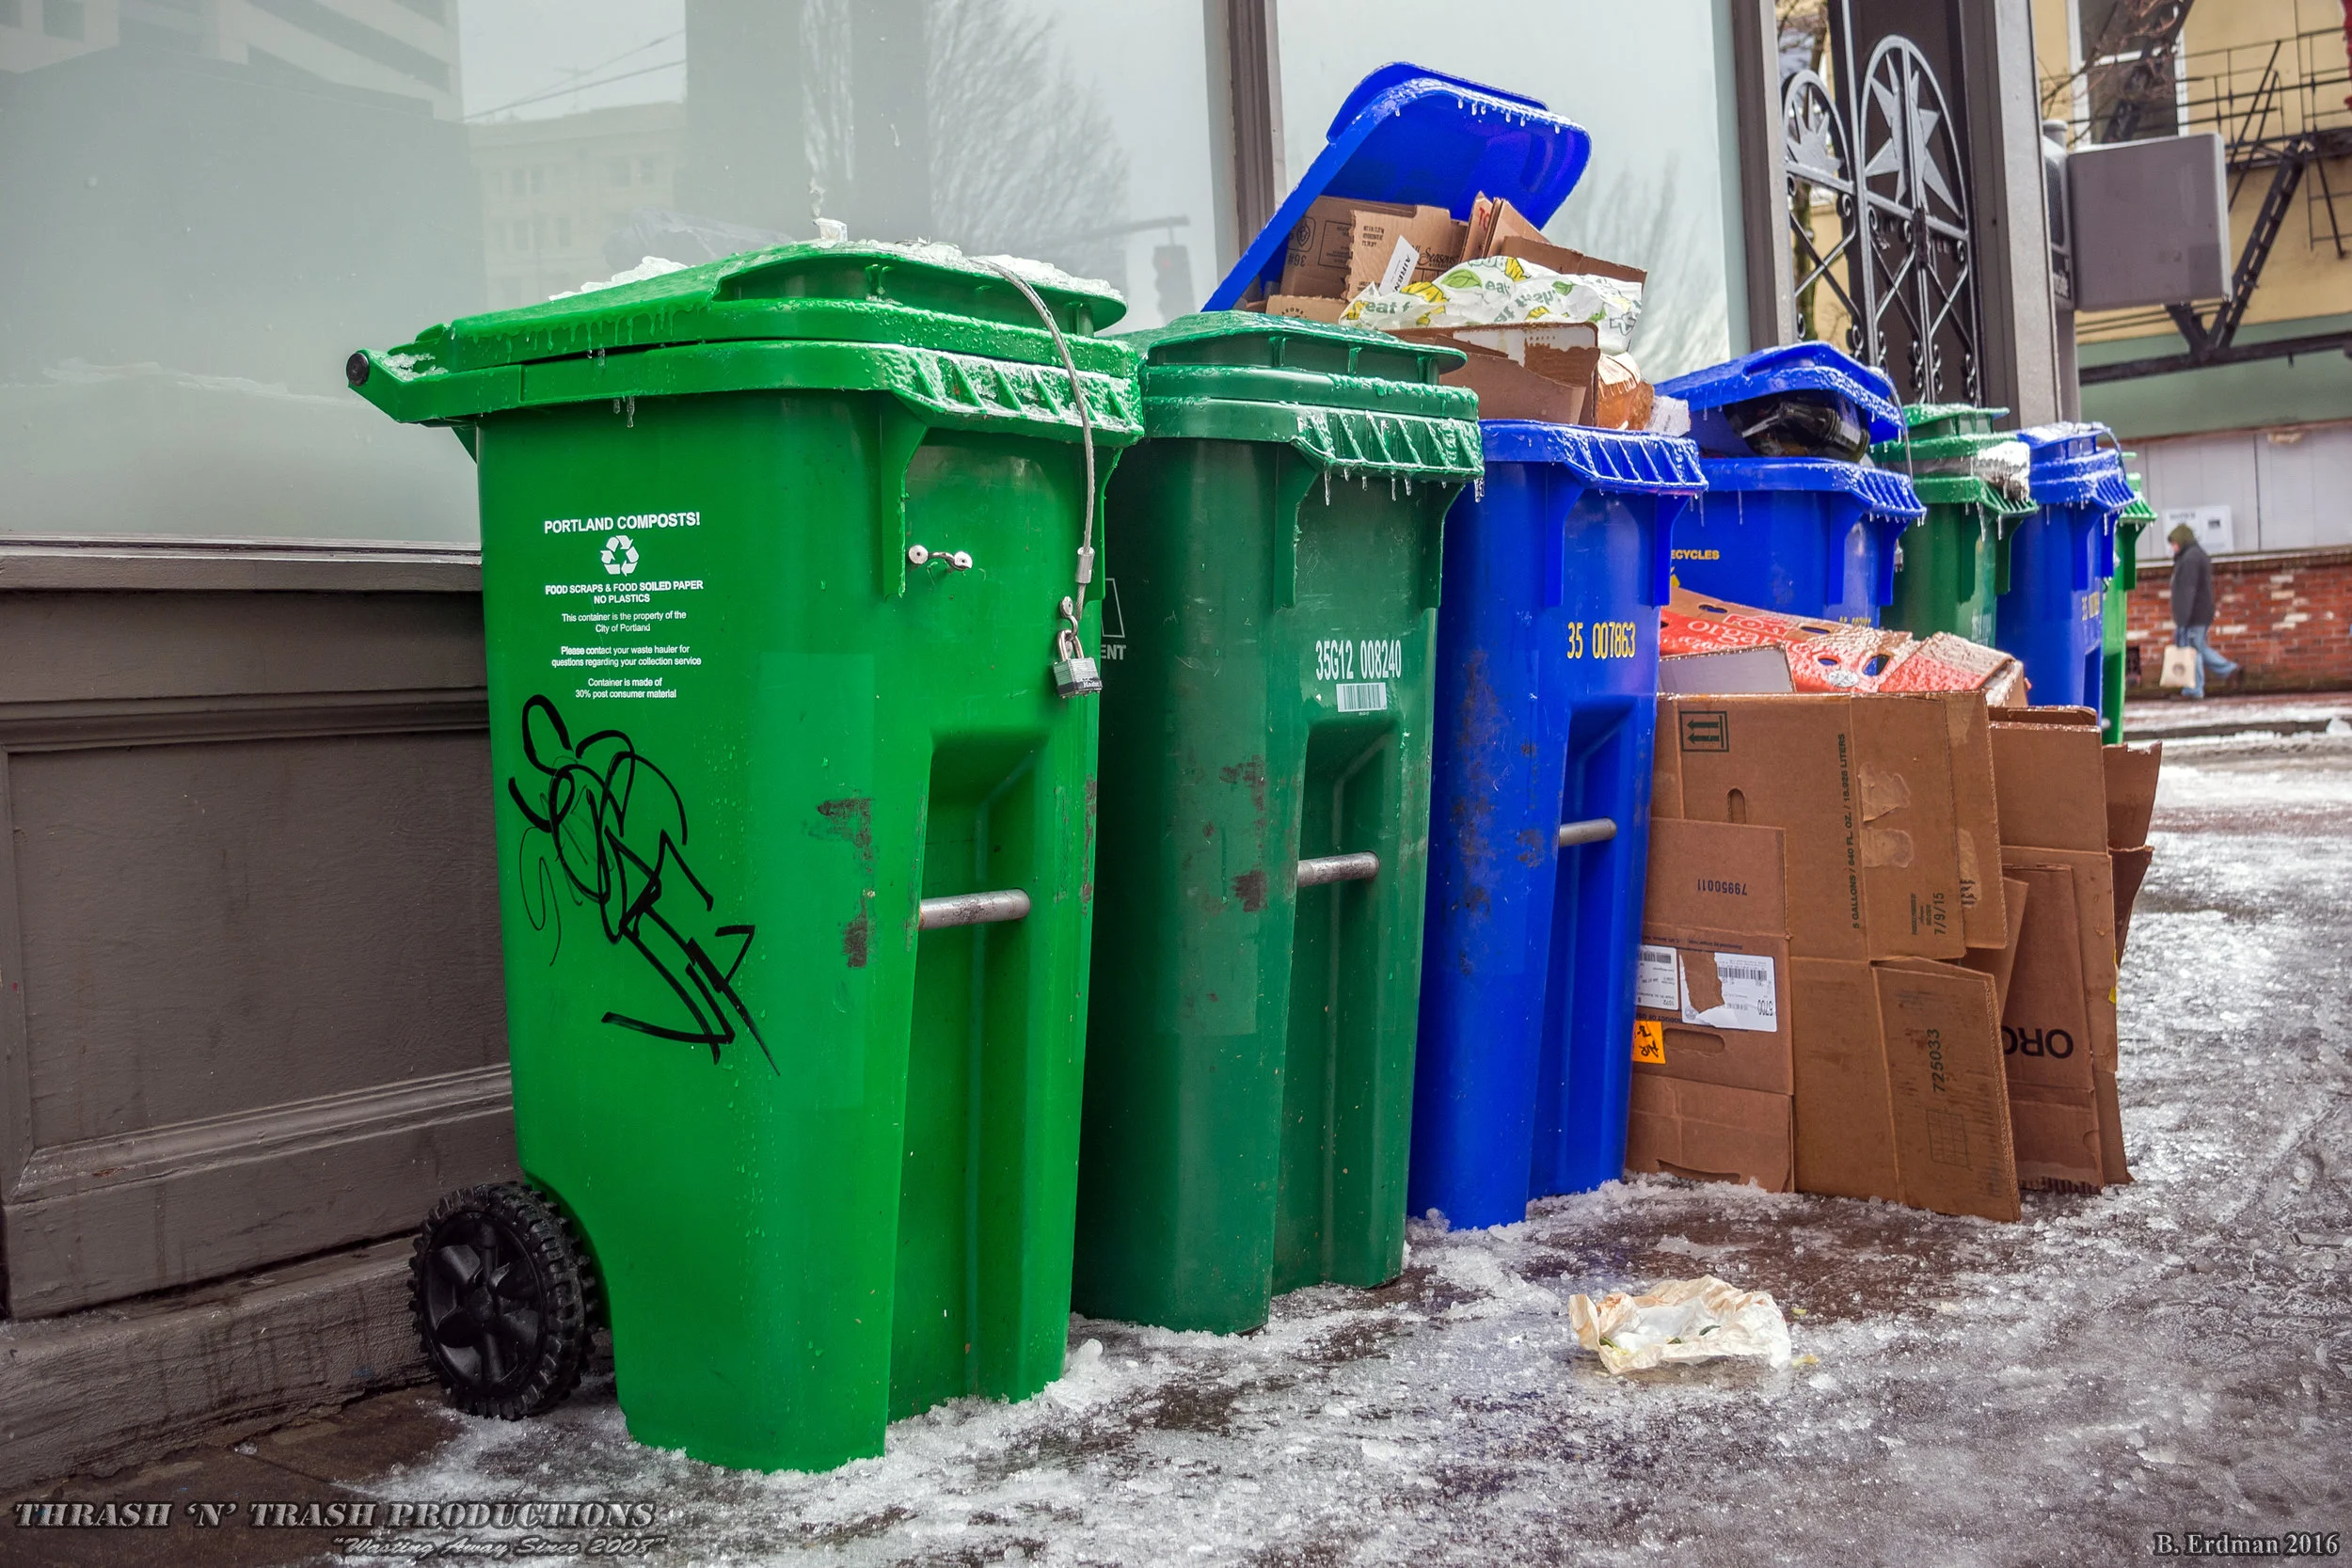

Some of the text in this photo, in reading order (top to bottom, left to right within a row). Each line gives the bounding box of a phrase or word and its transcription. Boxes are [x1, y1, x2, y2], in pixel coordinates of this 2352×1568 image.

[1392, 254, 1412, 293] AIRBN
[1365, 300, 1397, 315] eat
[544, 512, 700, 533] PORTLAND COMPOSTS!
[545, 580, 704, 595] FOOD SCRAPS & FOOD SOILED PAPER
[594, 594, 650, 604] NO PLASTICS
[562, 610, 687, 622] This container is the property of the
[596, 623, 650, 634] City of Portland
[1567, 622, 1583, 658] 35
[1592, 622, 1636, 658] 007863
[561, 644, 690, 656] Please contact your waste hauler for
[551, 657, 702, 668] questions regarding your collection service
[1316, 640, 1402, 680] 35G12 008240
[588, 677, 663, 687] Container is made of
[576, 689, 677, 699] 30% post consumer material
[1837, 733, 1848, 768] LITERS
[1849, 876, 1859, 919] GALLONS
[1933, 892, 1947, 935] 7/9/15
[1756, 999, 1773, 1017] 5700
[1927, 1028, 1946, 1093] 725033
